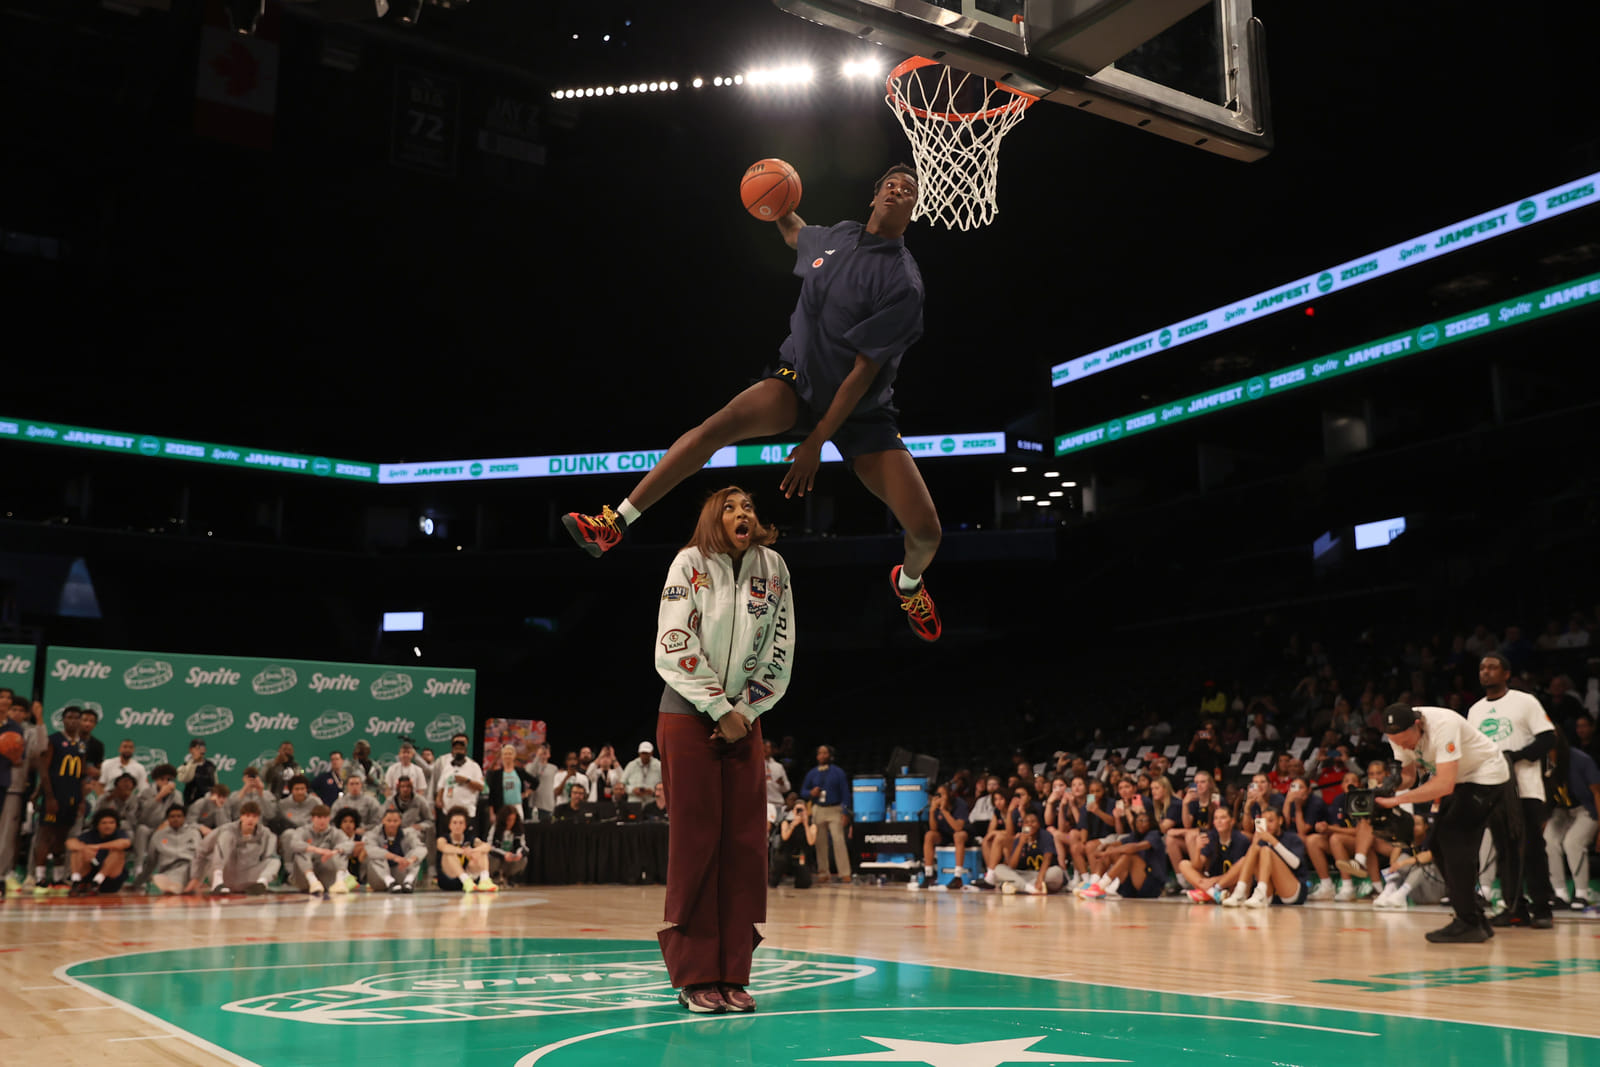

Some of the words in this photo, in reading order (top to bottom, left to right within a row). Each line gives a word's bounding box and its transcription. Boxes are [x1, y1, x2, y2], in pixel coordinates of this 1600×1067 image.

[407, 109, 446, 142] 72
[1106, 338, 1153, 363] JAMFEST
[1177, 319, 1208, 338] 2025
[1252, 283, 1310, 312] JAMFEST
[1340, 259, 1378, 281] 2025
[1398, 243, 1427, 261] Sprite
[1434, 213, 1508, 249] JAMFEST
[1546, 182, 1595, 210] 2025
[1057, 428, 1105, 451] JAMFEST
[1126, 412, 1157, 431] 2025
[1187, 387, 1244, 413] JAMFEST
[1269, 368, 1306, 389] 2025
[1312, 359, 1340, 377] Sprite
[1344, 335, 1412, 367] JAMFEST
[1445, 312, 1491, 338] 2025
[1498, 301, 1533, 322] Sprite
[63, 430, 135, 448] JAMFEST
[165, 442, 205, 457] 2025
[245, 453, 308, 469] JAMFEST
[335, 463, 372, 477] 2025
[414, 466, 464, 476] JAMFEST
[489, 464, 519, 473] 2025
[549, 455, 609, 474] DUNK
[963, 438, 996, 449] 2025
[51, 659, 112, 681] Sprite
[185, 666, 241, 688] Sprite
[308, 672, 360, 693] Sprite
[424, 677, 471, 698] Sprite
[116, 706, 174, 729] Sprite
[245, 712, 299, 733] Sprite
[365, 716, 415, 737] Sprite
[411, 971, 655, 990] Sprite
